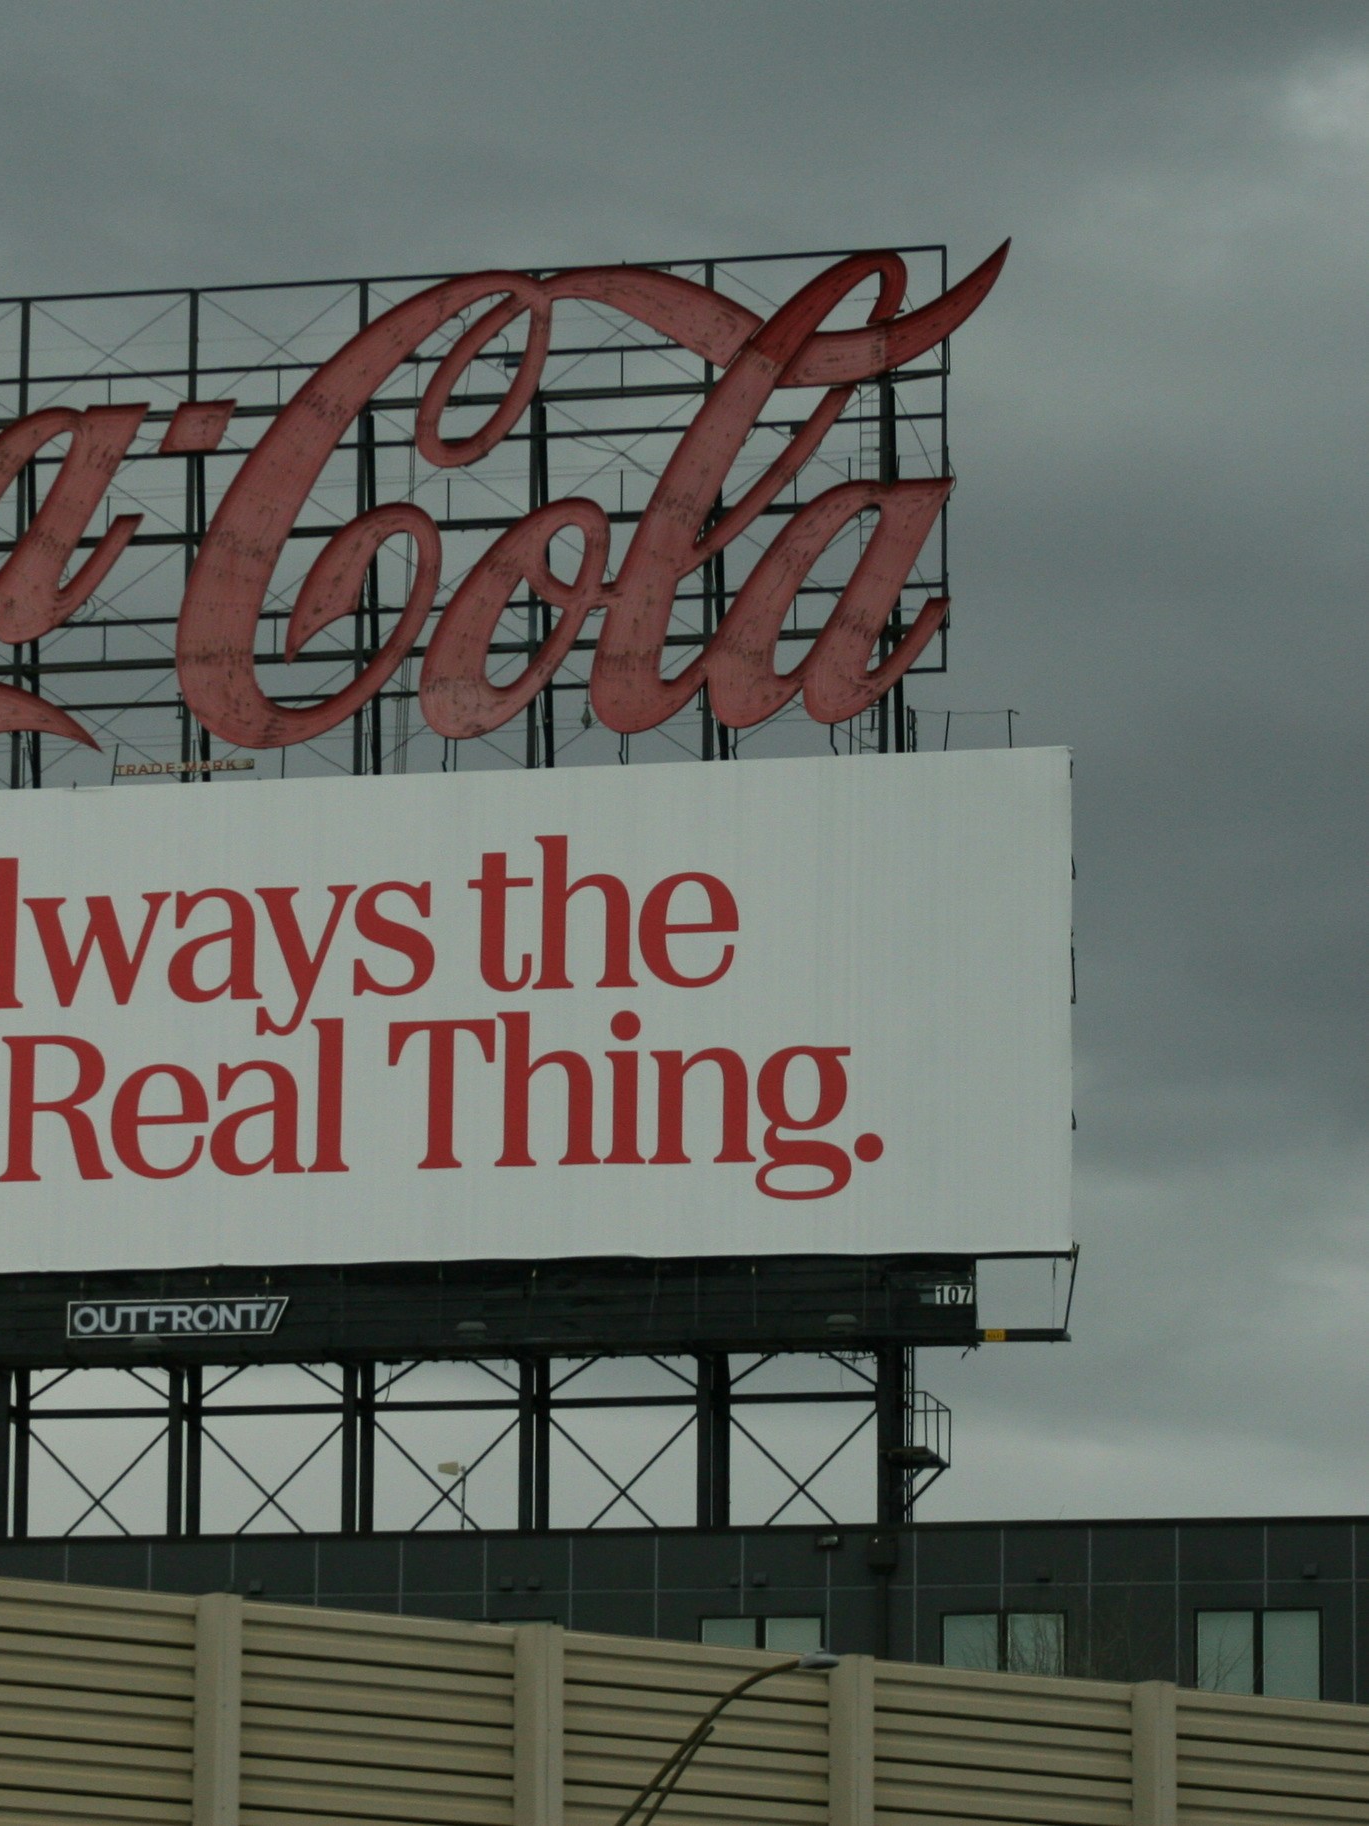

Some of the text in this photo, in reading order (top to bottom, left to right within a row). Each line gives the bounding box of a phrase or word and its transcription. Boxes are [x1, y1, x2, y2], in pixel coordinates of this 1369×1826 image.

[468, 834, 739, 991] the
[388, 1010, 884, 1200] Thing.
[937, 1286, 971, 1304] 107
